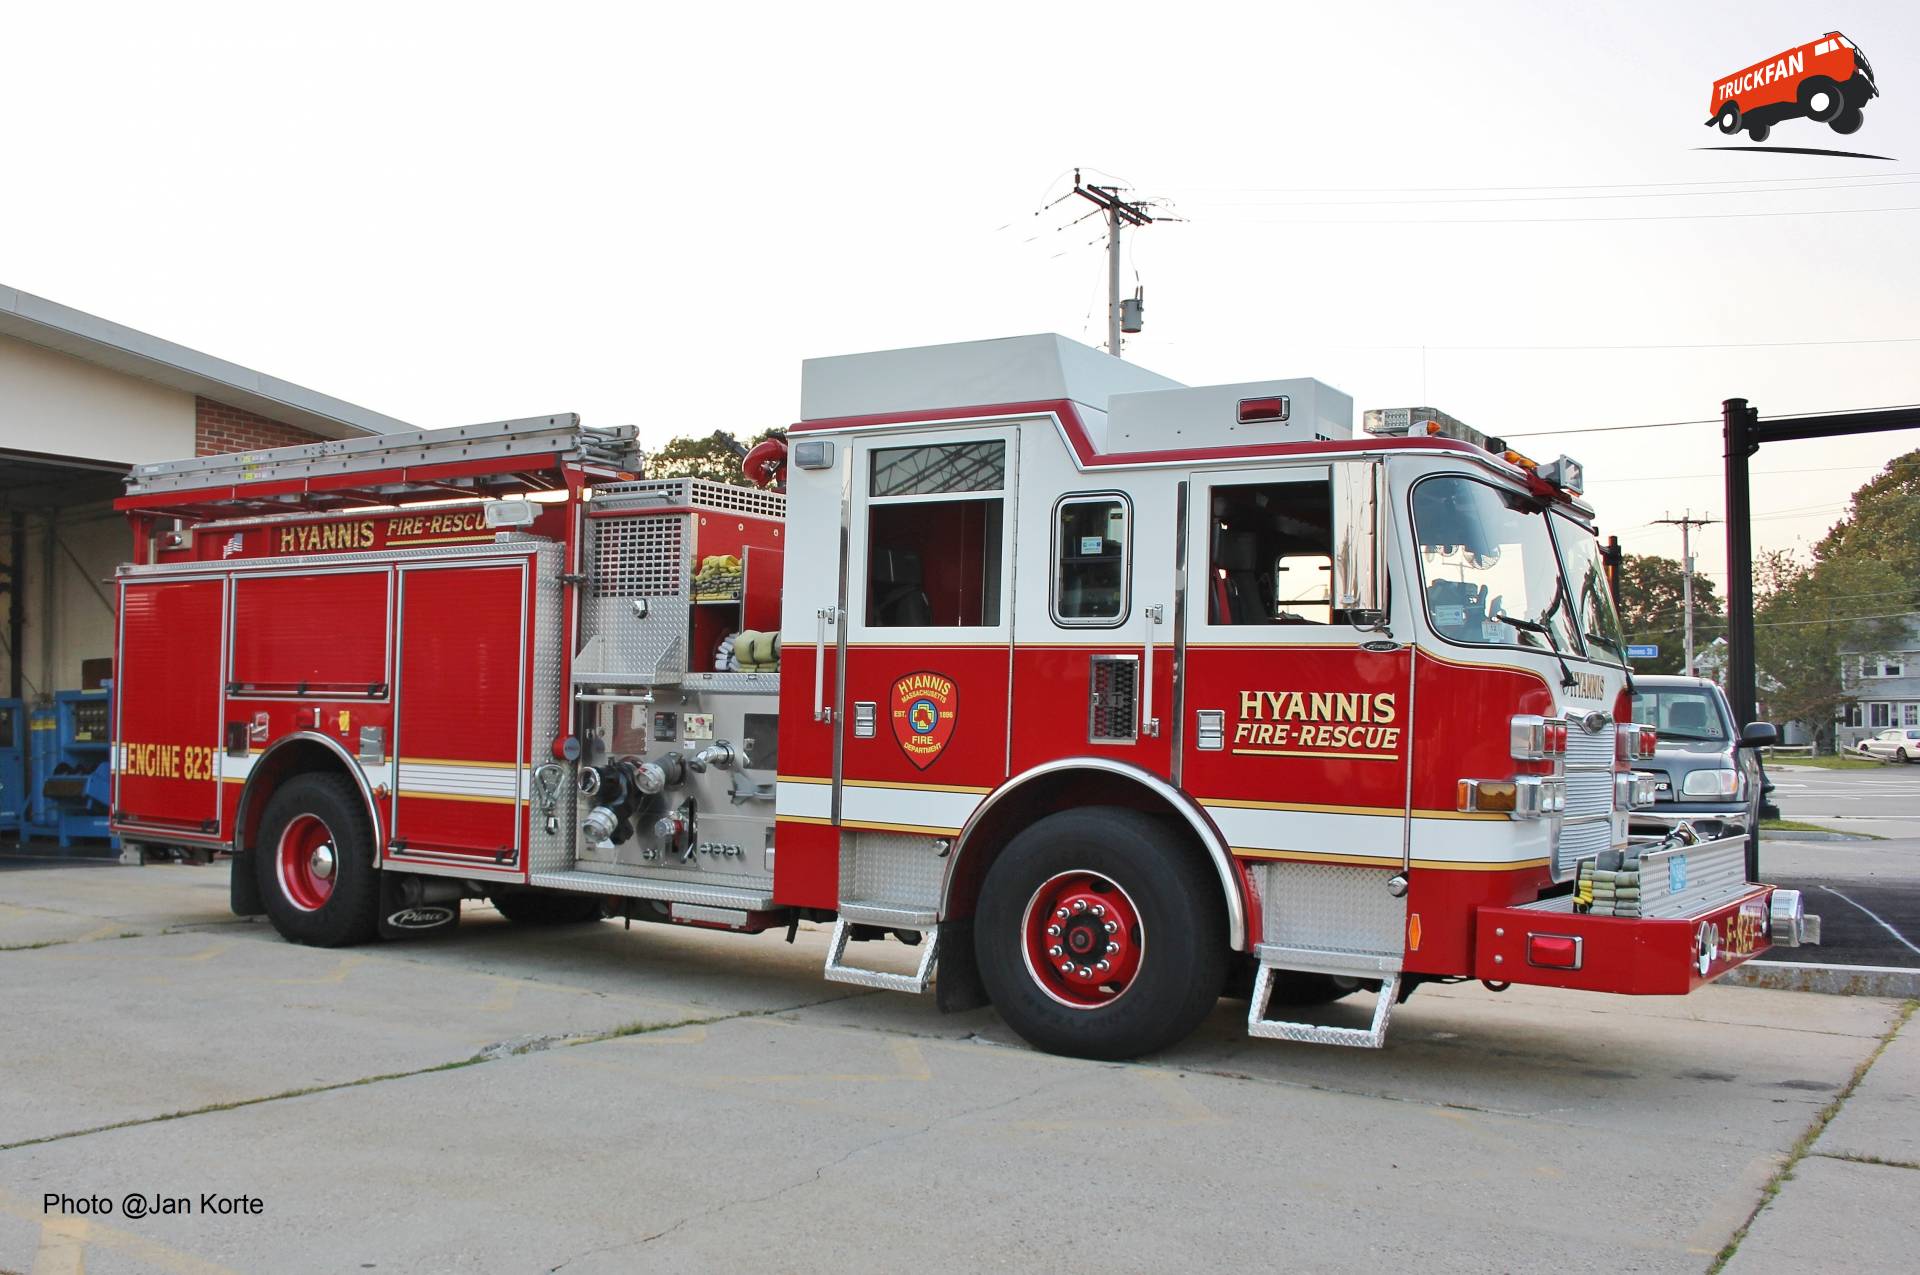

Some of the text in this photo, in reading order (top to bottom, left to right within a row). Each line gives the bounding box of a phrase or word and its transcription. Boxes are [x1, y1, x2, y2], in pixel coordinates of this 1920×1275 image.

[280, 513, 497, 552] HYANNIS FIRE-RESCU
[898, 675, 951, 696] HYANNIS
[901, 689, 947, 703] MASSACHUSETTS
[1240, 690, 1396, 724] HYANNIS
[912, 735, 934, 744] FIRE
[1233, 723, 1400, 749] FIRE-RESCUE
[904, 742, 942, 754] DEPARTMENT
[127, 743, 212, 780] ENGINE 823
[400, 910, 443, 923] Pierce
